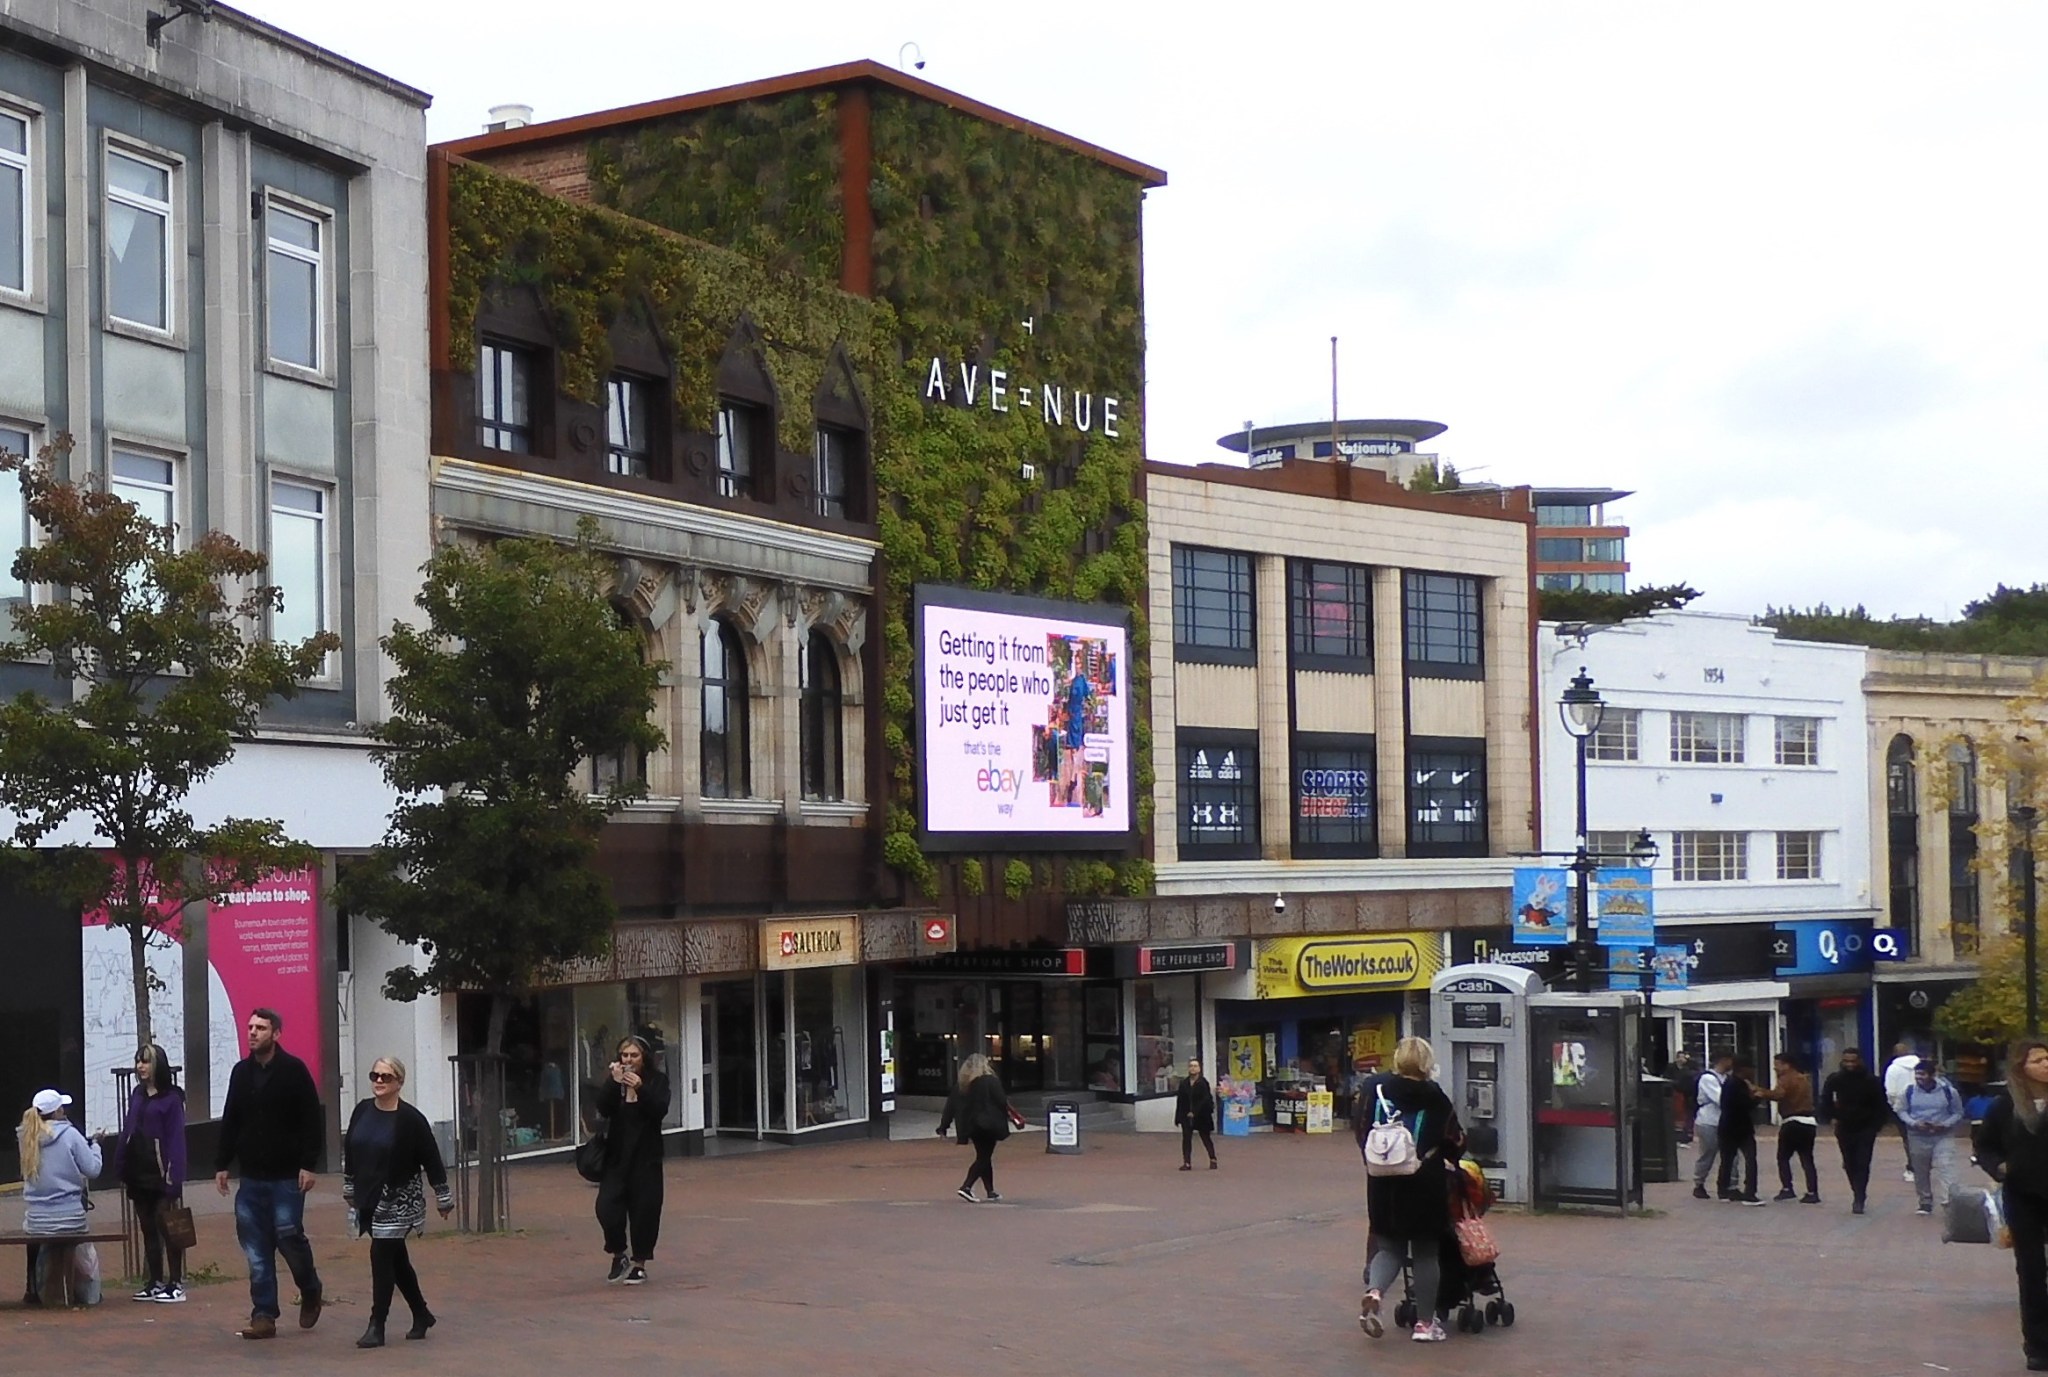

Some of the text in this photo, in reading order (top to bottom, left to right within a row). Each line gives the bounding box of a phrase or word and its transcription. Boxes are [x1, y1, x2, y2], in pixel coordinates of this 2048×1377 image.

[926, 357, 1119, 437] AVENUE
[1336, 441, 1402, 455] Nationwide
[939, 630, 1044, 665] Getting it from
[939, 663, 1050, 698] the people who
[939, 695, 1009, 730] just get it
[988, 741, 1001, 755] the
[977, 759, 1024, 800] ebay
[1301, 769, 1368, 797] SPORTS
[997, 804, 1013, 818] way
[246, 888, 272, 906] place
[273, 888, 284, 900] to
[285, 887, 310, 904] shop.
[793, 930, 842, 953] SALTROCK
[945, 957, 1010, 968] PERFUME
[1022, 957, 1063, 968] SHOP
[1152, 952, 1225, 965] THE PERFUME SHOP
[1268, 957, 1282, 966] The
[1305, 950, 1414, 978] TheWorks.co.uk
[1263, 966, 1287, 974] Works
[1458, 980, 1493, 992] cash
[918, 1068, 942, 1077] BOSS
